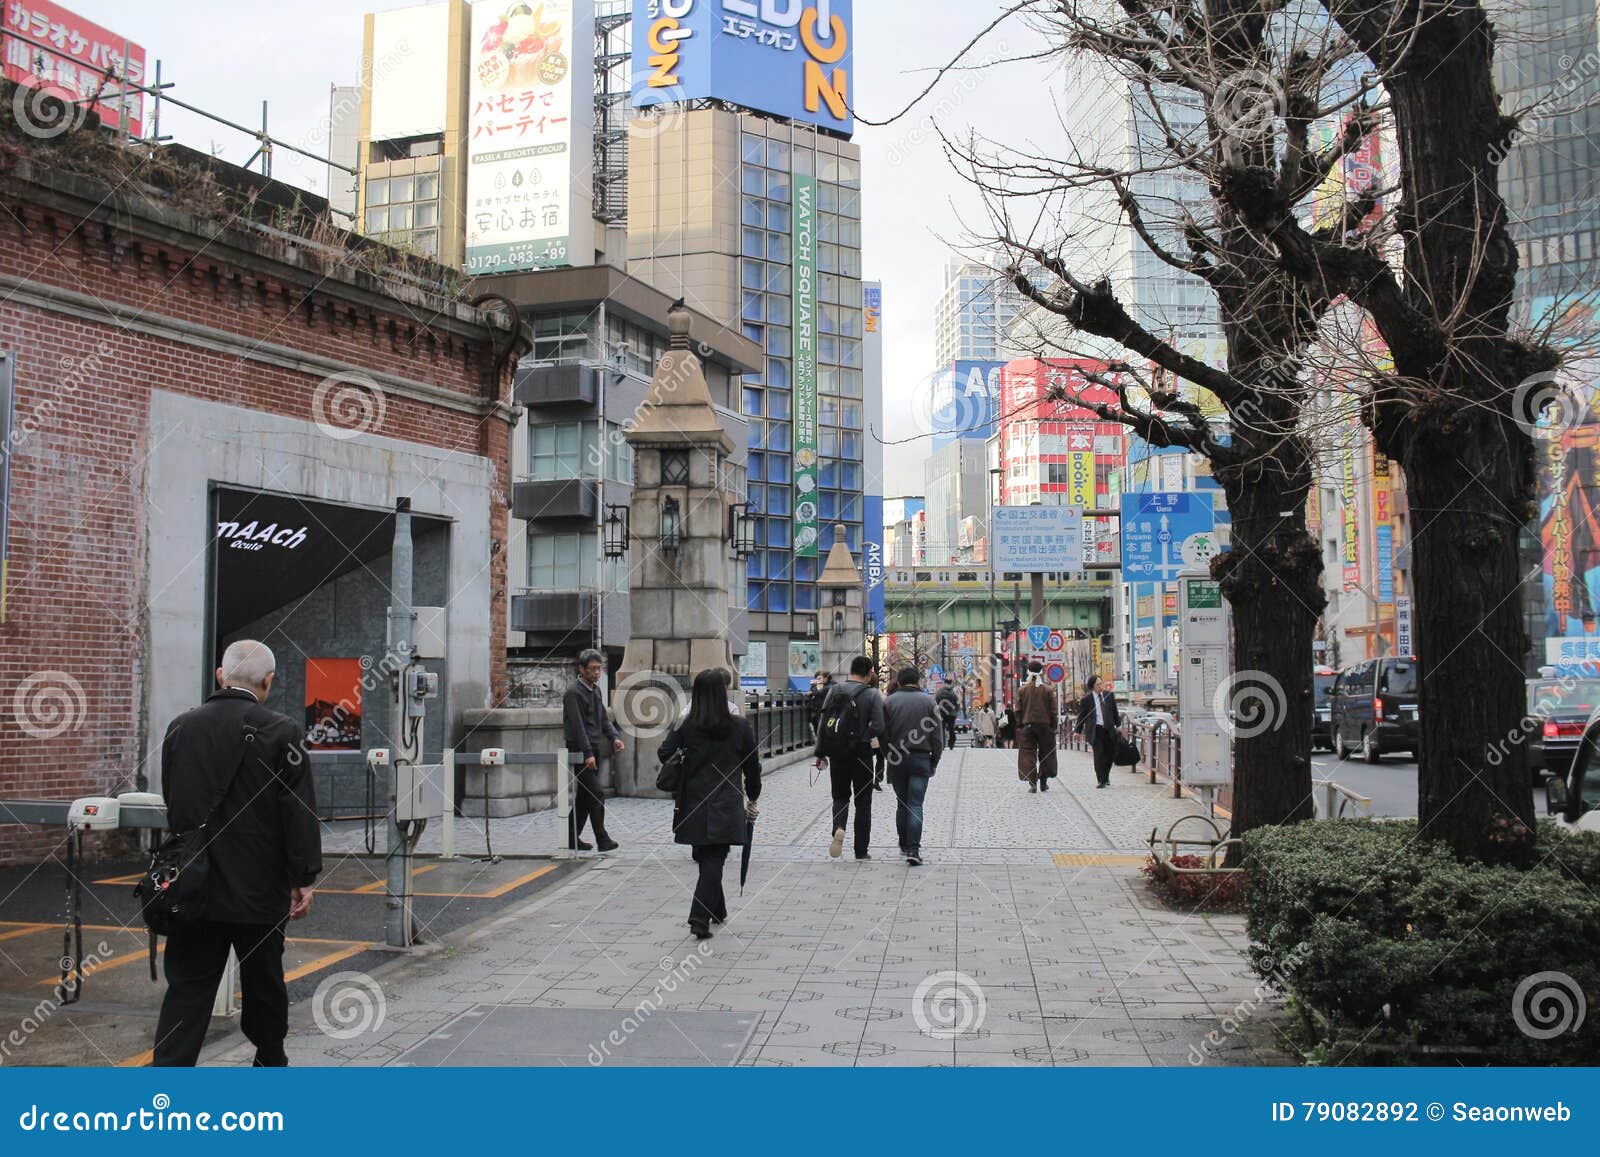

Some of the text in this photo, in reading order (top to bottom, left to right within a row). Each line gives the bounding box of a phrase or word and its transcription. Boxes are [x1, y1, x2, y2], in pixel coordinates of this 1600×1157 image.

[9, 1, 88, 55] カラオケ
[721, 15, 797, 51] エディオン
[473, 90, 554, 116] パセラで
[473, 115, 568, 140] パーティー
[475, 204, 560, 234] 安心お宿
[798, 185, 811, 351] WATCH SQUARE
[1151, 494, 1178, 506] 上野
[1377, 490, 1388, 521] DVD
[868, 543, 881, 589] AKIBA
[1033, 632, 1043, 643] 17
